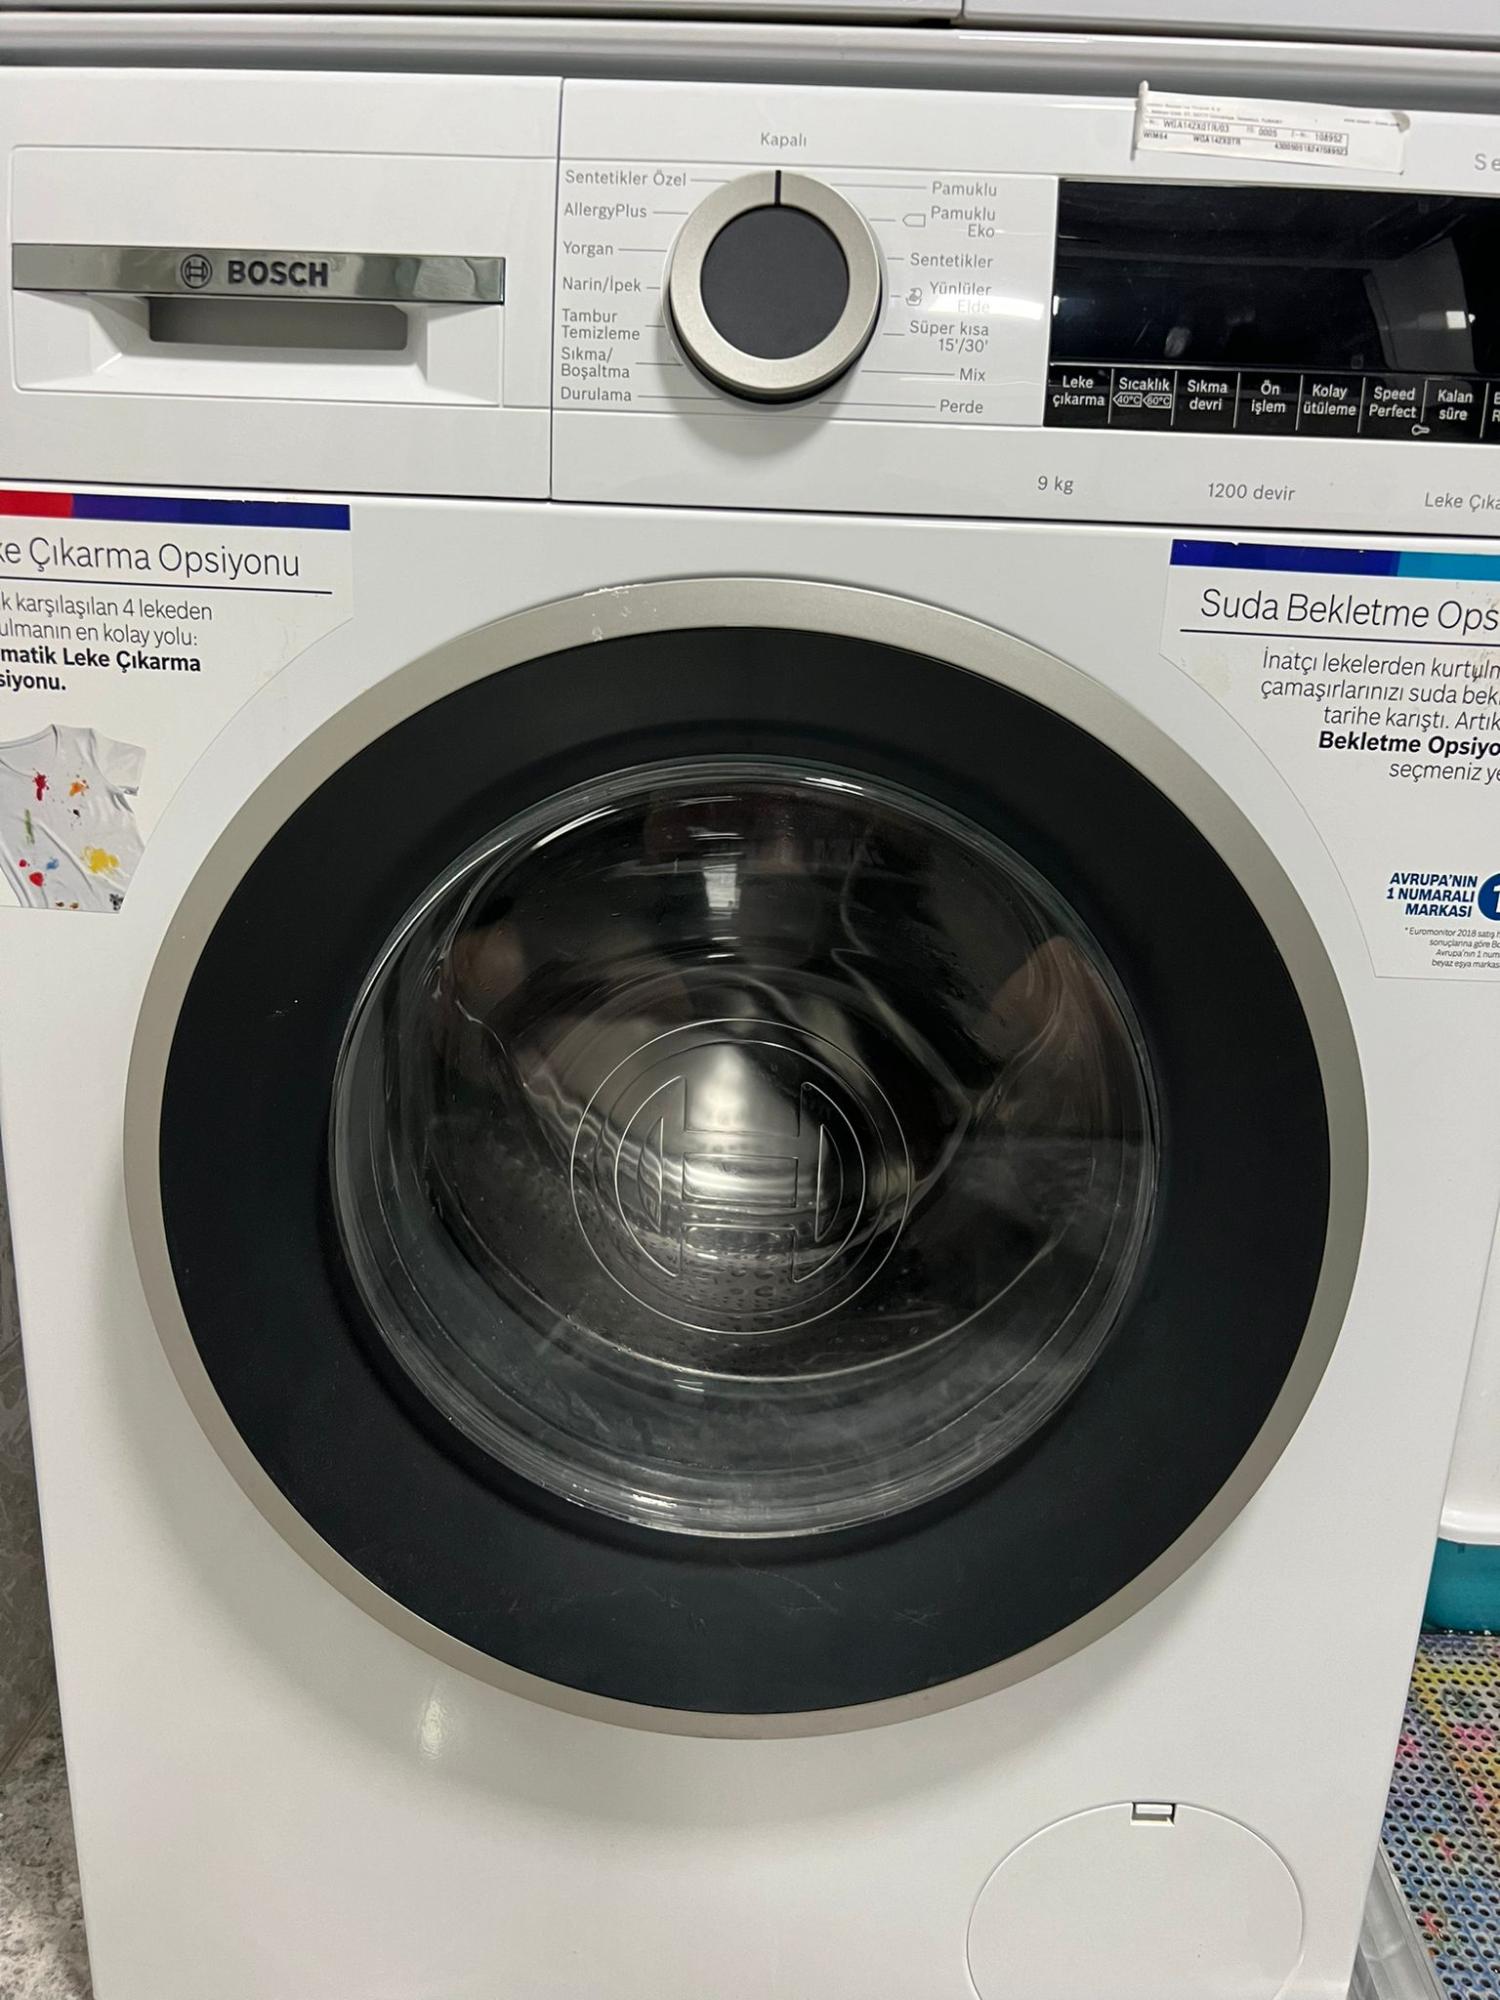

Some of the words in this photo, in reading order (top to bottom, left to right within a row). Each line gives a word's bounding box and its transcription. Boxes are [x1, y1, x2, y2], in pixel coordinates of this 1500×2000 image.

[760, 132, 807, 149] Kapalı
[1474, 152, 1500, 172] Se
[565, 170, 648, 186] Sentetikler
[653, 170, 687, 187] Özel
[931, 180, 998, 198] Pamuklu
[563, 202, 648, 219] AllergyPlus
[930, 205, 996, 222] Pamuklu
[967, 223, 995, 239] Eko
[562, 241, 614, 257] Yorgan
[909, 252, 994, 270] Sentetikler
[227, 259, 329, 288] BOSCH
[561, 275, 642, 295] Narin/İpek
[929, 281, 993, 297] Yünlüler
[561, 308, 618, 323] Tambur
[957, 300, 991, 315] Elde
[561, 325, 641, 341] Temizleme
[909, 319, 956, 337] Süper
[960, 322, 989, 337] kısa
[560, 346, 614, 364] Sıkma/
[560, 363, 631, 381] Boşaltma
[959, 367, 986, 382] Mix
[1062, 375, 1094, 389] Leke
[1118, 377, 1170, 392] Sıcaklık
[1187, 379, 1228, 394] Sıkma
[1261, 379, 1280, 396] Ön
[560, 386, 632, 402] Durulama
[1312, 383, 1348, 399] Kolay
[1374, 386, 1416, 403] Speed
[1437, 389, 1474, 404] Kalan
[939, 399, 984, 414] Perde
[1052, 392, 1105, 408] çıkarma
[1189, 397, 1223, 412] devri
[1251, 399, 1286, 415] işlem
[1303, 402, 1357, 417] ütüleme
[1369, 403, 1417, 419] Perfect
[1439, 407, 1468, 420] süre
[1037, 475, 1048, 491] 9
[1054, 476, 1074, 495] kg
[1208, 483, 1248, 499] 1200
[1253, 484, 1296, 502] devir
[1425, 492, 1463, 508] Leke
[29, 536, 152, 573] Çıkarma
[158, 542, 300, 580] Opsiyonu
[16, 592, 119, 620] karşılaşılan
[122, 599, 135, 617] 4
[138, 600, 213, 621] lekeden
[1201, 588, 1279, 621] Suda
[1287, 592, 1429, 629] Bekletme
[1437, 600, 1499, 636] Ops
[76, 626, 98, 641] en
[103, 623, 150, 648] kolay
[155, 629, 198, 653] yolu:
[1, 645, 58, 665] matik
[63, 647, 110, 668] Leke
[116, 650, 202, 673] Çıkarma
[1262, 646, 1317, 674] İnatçı
[1321, 653, 1426, 677] lekelerden
[1261, 679, 1403, 702] çamaşırlarınızı
[1408, 684, 1457, 704] suda
[1462, 685, 1500, 706] bek
[1324, 706, 1381, 726] tarihe
[1385, 710, 1450, 733] karıştı.
[1318, 730, 1421, 754] Bekletme
[1428, 735, 1500, 760] Opsiyo
[1389, 762, 1482, 783] seçmeniz
[1387, 887, 1394, 899] 1
[1398, 888, 1475, 903] NUMARALI
[1405, 903, 1472, 918] MARKASI
[1409, 927, 1456, 937] Euromonitor
[1457, 929, 1477, 938] 2018
